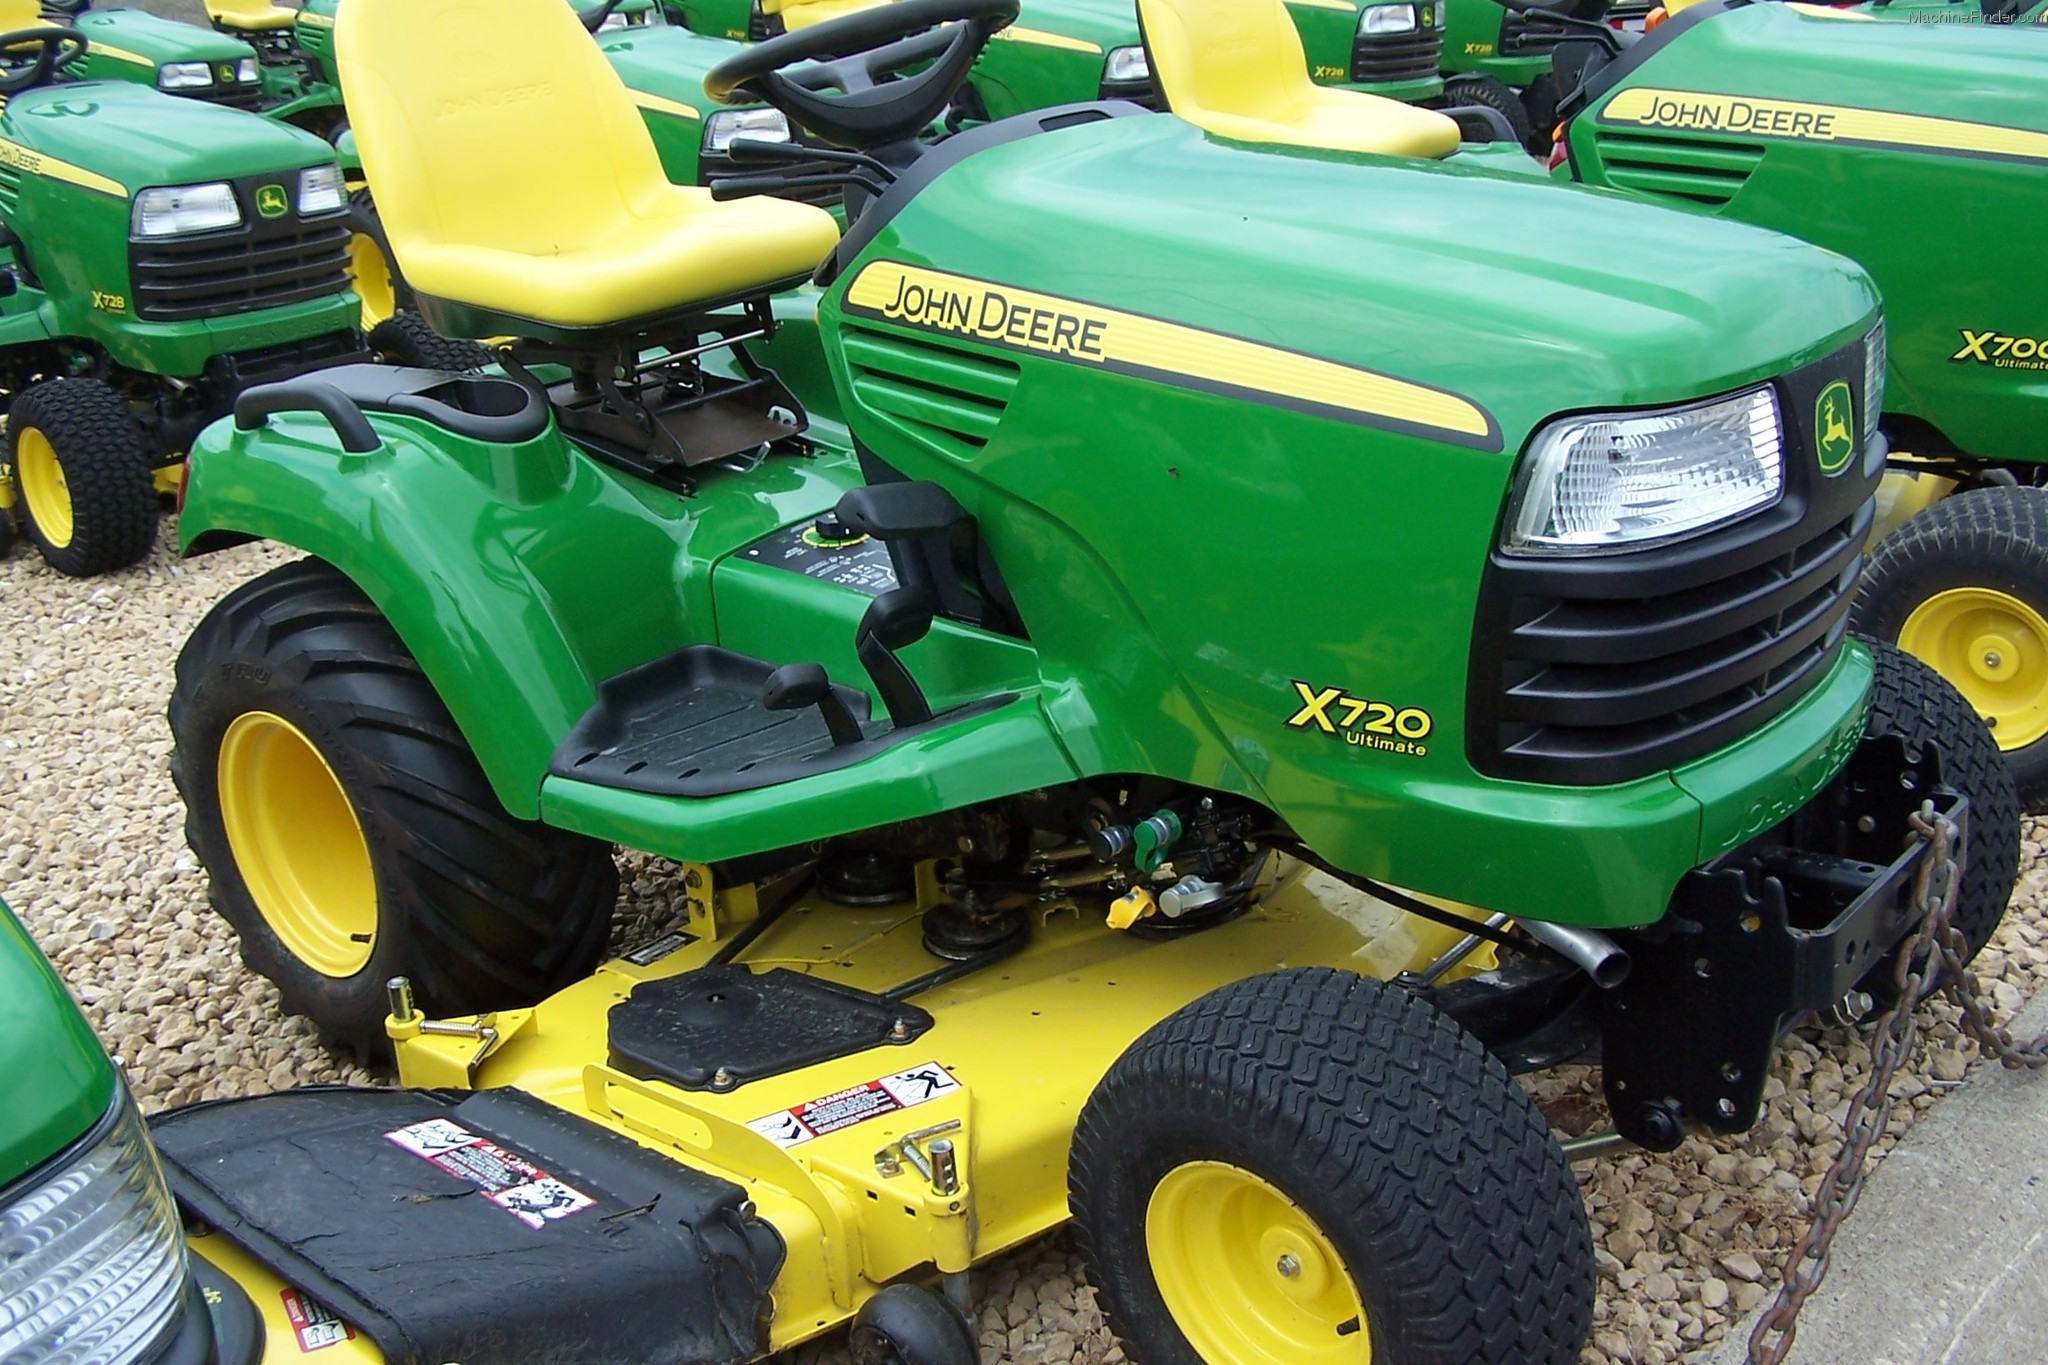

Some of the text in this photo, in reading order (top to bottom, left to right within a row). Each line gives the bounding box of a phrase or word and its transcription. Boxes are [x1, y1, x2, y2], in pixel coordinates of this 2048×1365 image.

[1640, 96, 1835, 135] JOHN DEERE
[885, 275, 1107, 355] JOHN DEERE
[1287, 682, 1432, 740] X720
[1346, 731, 1428, 757] Ultimate
[816, 1083, 870, 1107] DANGER
